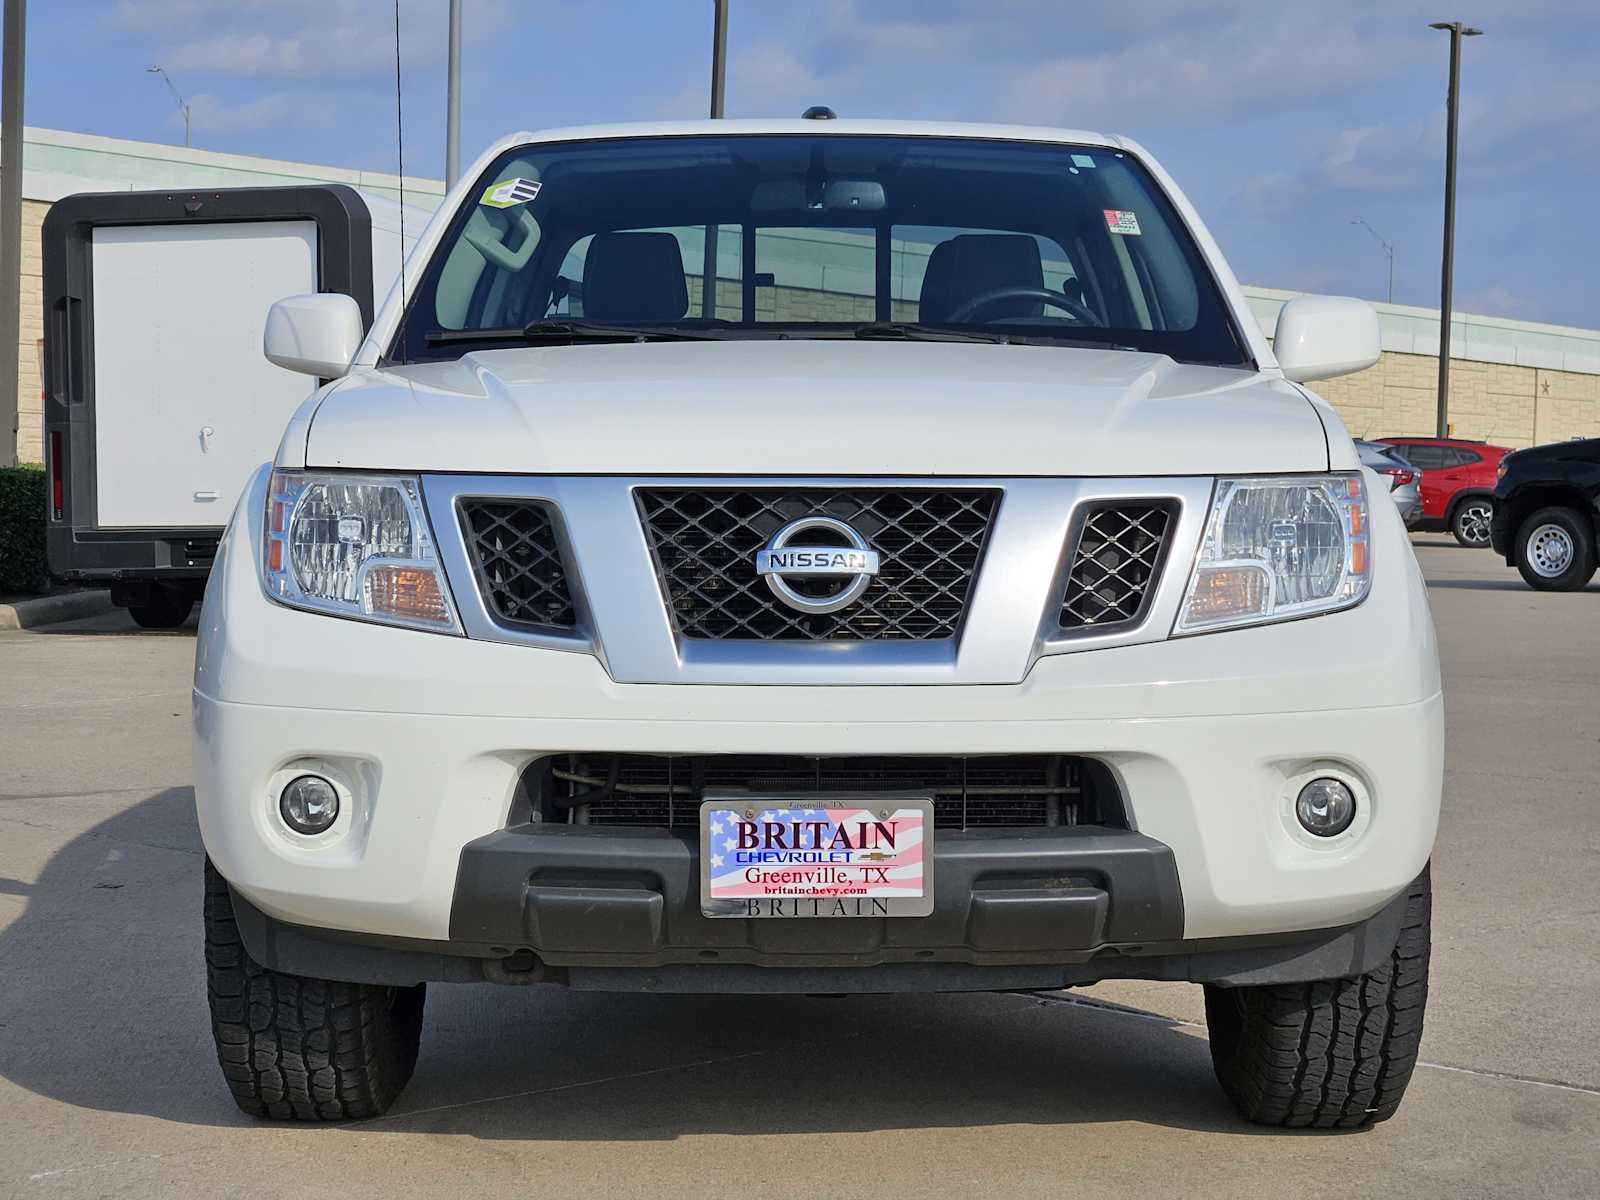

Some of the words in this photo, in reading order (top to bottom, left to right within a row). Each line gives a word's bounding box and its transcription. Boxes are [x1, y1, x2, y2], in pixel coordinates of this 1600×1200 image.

[770, 553, 866, 568] NISSAN
[736, 821, 898, 850] BRITAIN
[736, 852, 854, 863] CHEVROLET
[745, 867, 853, 885] Greenville,
[860, 867, 890, 884] TX
[764, 886, 867, 896] britainchevy.com
[747, 898, 889, 916] BRITAIN
